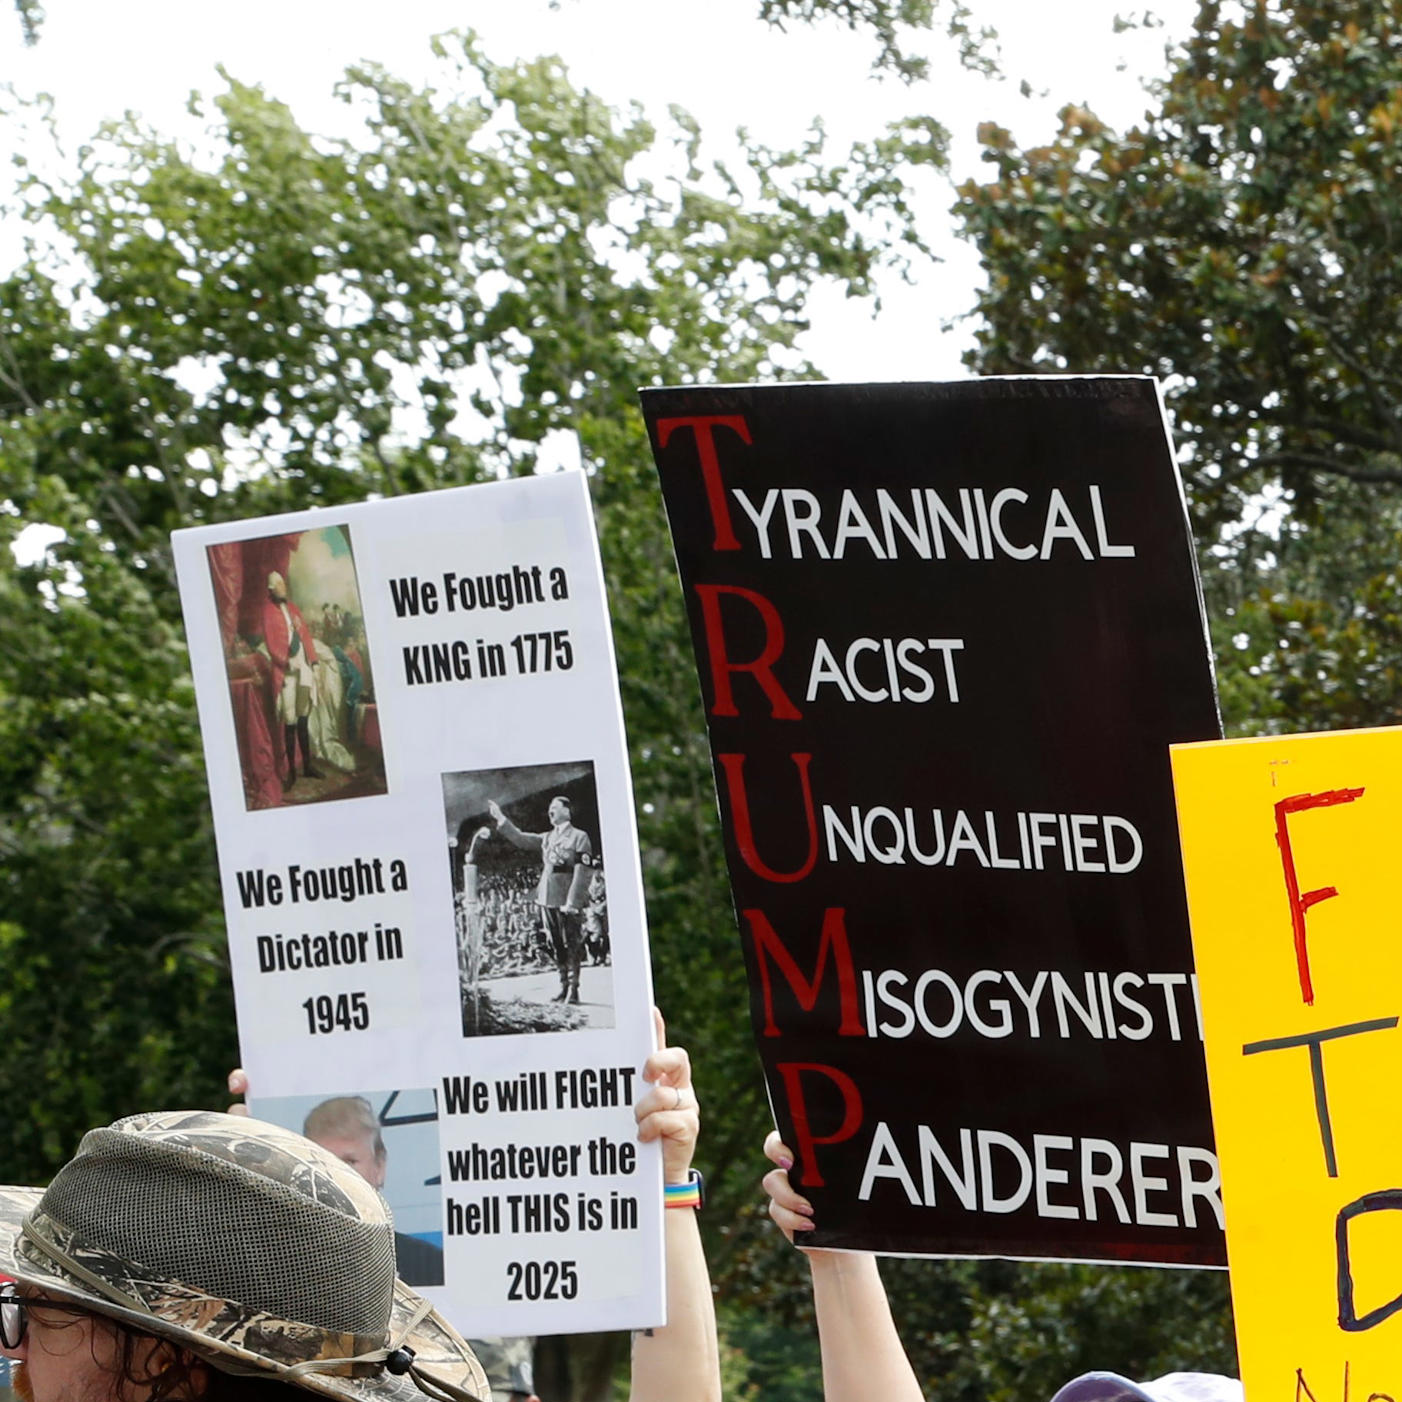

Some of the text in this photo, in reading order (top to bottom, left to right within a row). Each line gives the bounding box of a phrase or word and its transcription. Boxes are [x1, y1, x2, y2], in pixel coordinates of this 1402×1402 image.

[656, 415, 1135, 560] TYRANNICAL
[390, 566, 569, 618] We Fought a
[403, 632, 573, 685] KING in 1775
[694, 585, 965, 719] RACIST
[719, 753, 1143, 883] UNQUALIFIED
[236, 858, 408, 907] We Fought a
[257, 923, 403, 974] Dictator in
[302, 993, 370, 1035] 1945
[442, 1068, 636, 1114] We will FIGHT
[448, 1137, 636, 1183] whatever the
[777, 1064, 1225, 1231] PANDERER
[446, 1191, 638, 1235] hell THIS is in
[506, 1261, 578, 1302] 2025
